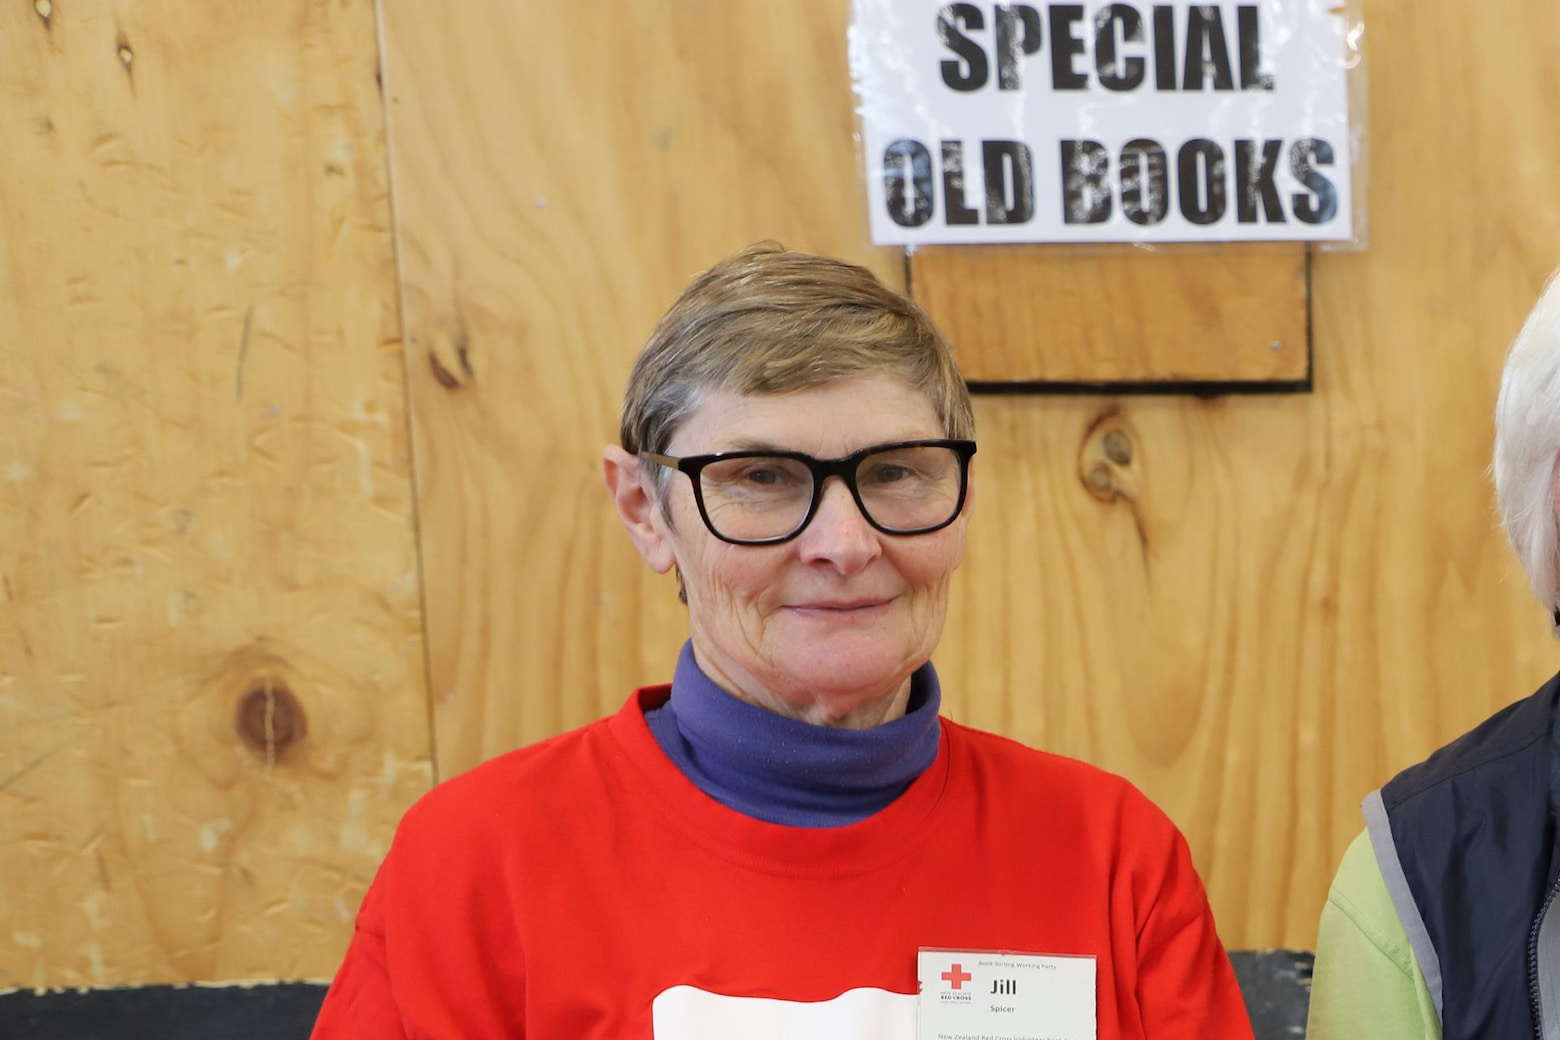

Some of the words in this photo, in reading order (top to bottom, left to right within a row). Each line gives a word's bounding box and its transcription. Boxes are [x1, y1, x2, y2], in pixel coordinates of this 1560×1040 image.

[937, 2, 1276, 92] SPECIAL
[883, 138, 1034, 228] OLD
[1060, 138, 1338, 226] BOOKS
[1016, 962, 1040, 970] Working
[990, 979, 1017, 995] Jill
[990, 1005, 1015, 1013] Spicer
